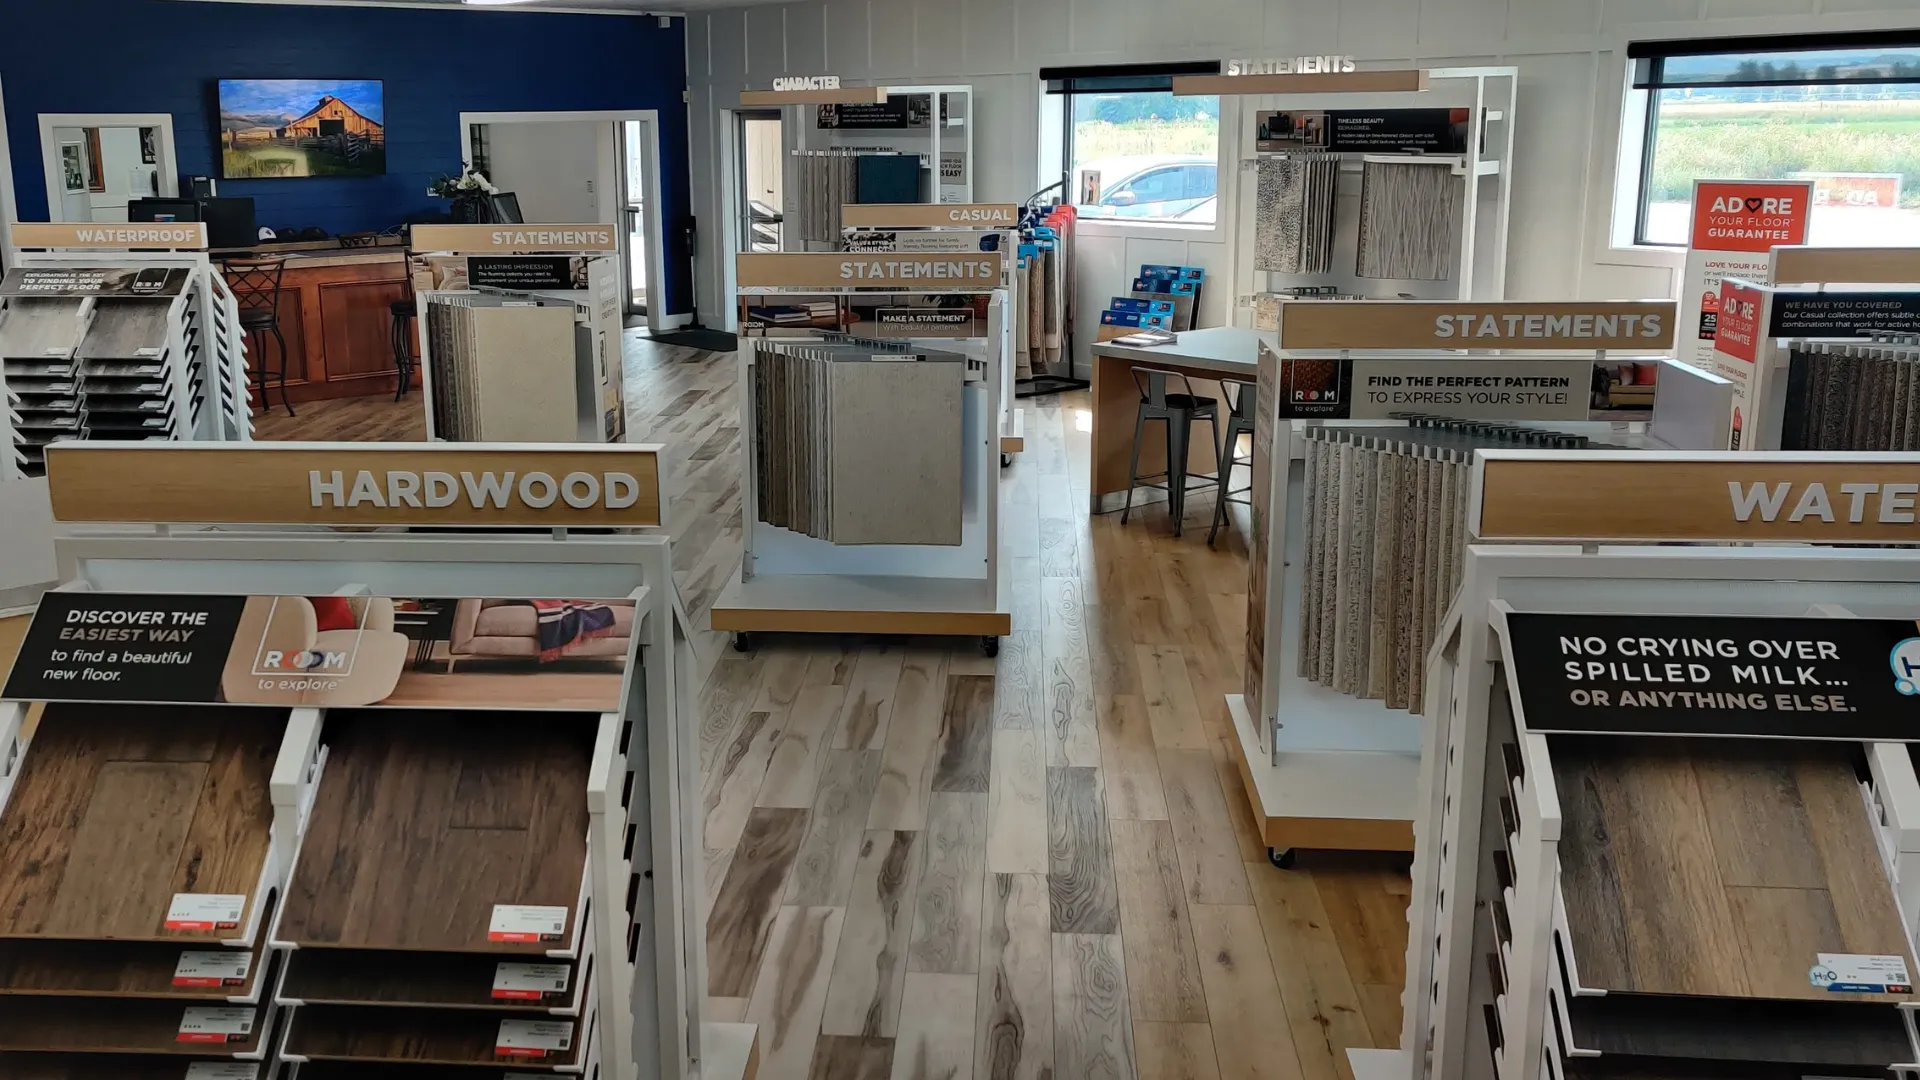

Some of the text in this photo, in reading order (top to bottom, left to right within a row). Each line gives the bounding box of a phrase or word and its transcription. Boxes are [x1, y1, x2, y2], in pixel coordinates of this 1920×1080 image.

[1228, 55, 1355, 76] STATEMENTS
[773, 76, 841, 91] CHARACTER
[949, 210, 1012, 221] CASUAL
[1709, 216, 1743, 226] YOUR
[76, 229, 195, 242] WATERPROOF
[492, 231, 609, 245] STATEMENTS
[1708, 228, 1789, 240] GUARANTEE
[840, 261, 992, 279] STATEMENTS
[1704, 314, 1716, 322] 25
[1434, 314, 1662, 338] STATEMENTS
[1721, 328, 1750, 346] GUARANTEE
[1368, 376, 1569, 388] FIND THE PERFECT PATTERN
[1368, 392, 1568, 405] TO EXPRESS YOUR STYLE!
[309, 470, 639, 509] HARDWOOD
[65, 609, 208, 625] DISCOVER THE
[58, 627, 195, 643] EASIEST WAY
[1560, 636, 1840, 660] NO CRYING OVER
[51, 649, 192, 665] to find a beautiful
[263, 651, 347, 669] ROOM
[42, 667, 121, 682] new floor.
[1565, 661, 1710, 683] SPILLED
[258, 678, 274, 690] to
[1570, 690, 1858, 712] OR ANYTHING ELSE.
[1813, 971, 1837, 981] H2O
